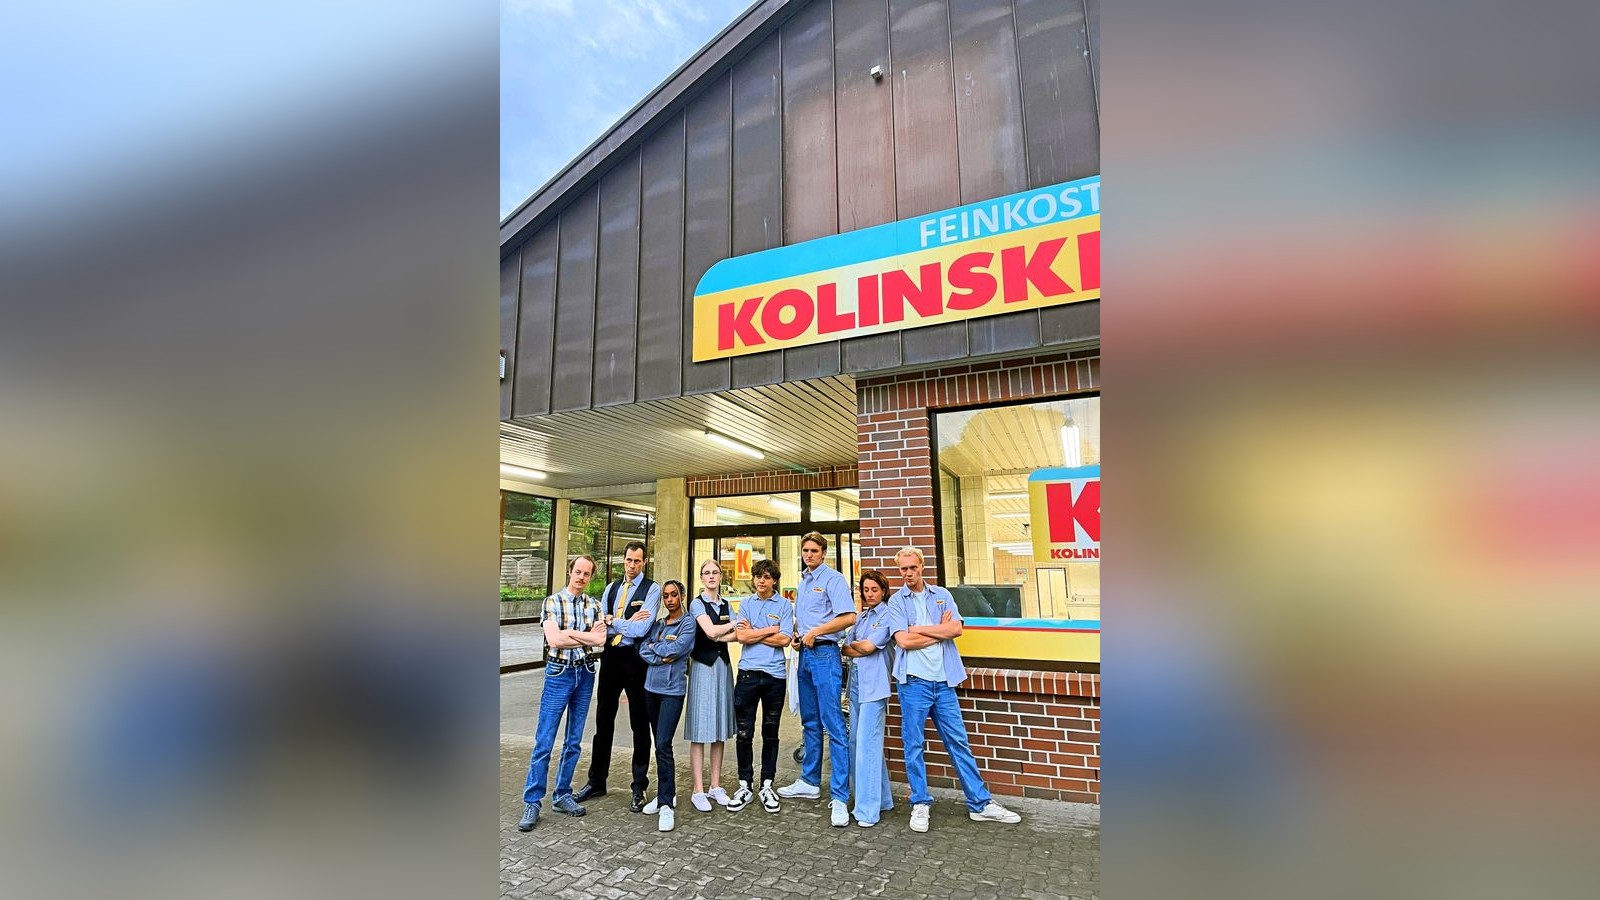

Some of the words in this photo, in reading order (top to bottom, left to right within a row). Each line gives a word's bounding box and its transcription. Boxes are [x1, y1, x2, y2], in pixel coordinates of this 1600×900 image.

[920, 182, 1100, 247] FEINKOST
[717, 230, 1100, 351] KOLINSKI
[1046, 481, 1100, 543] K
[738, 549, 749, 573] K
[784, 590, 795, 601] K
